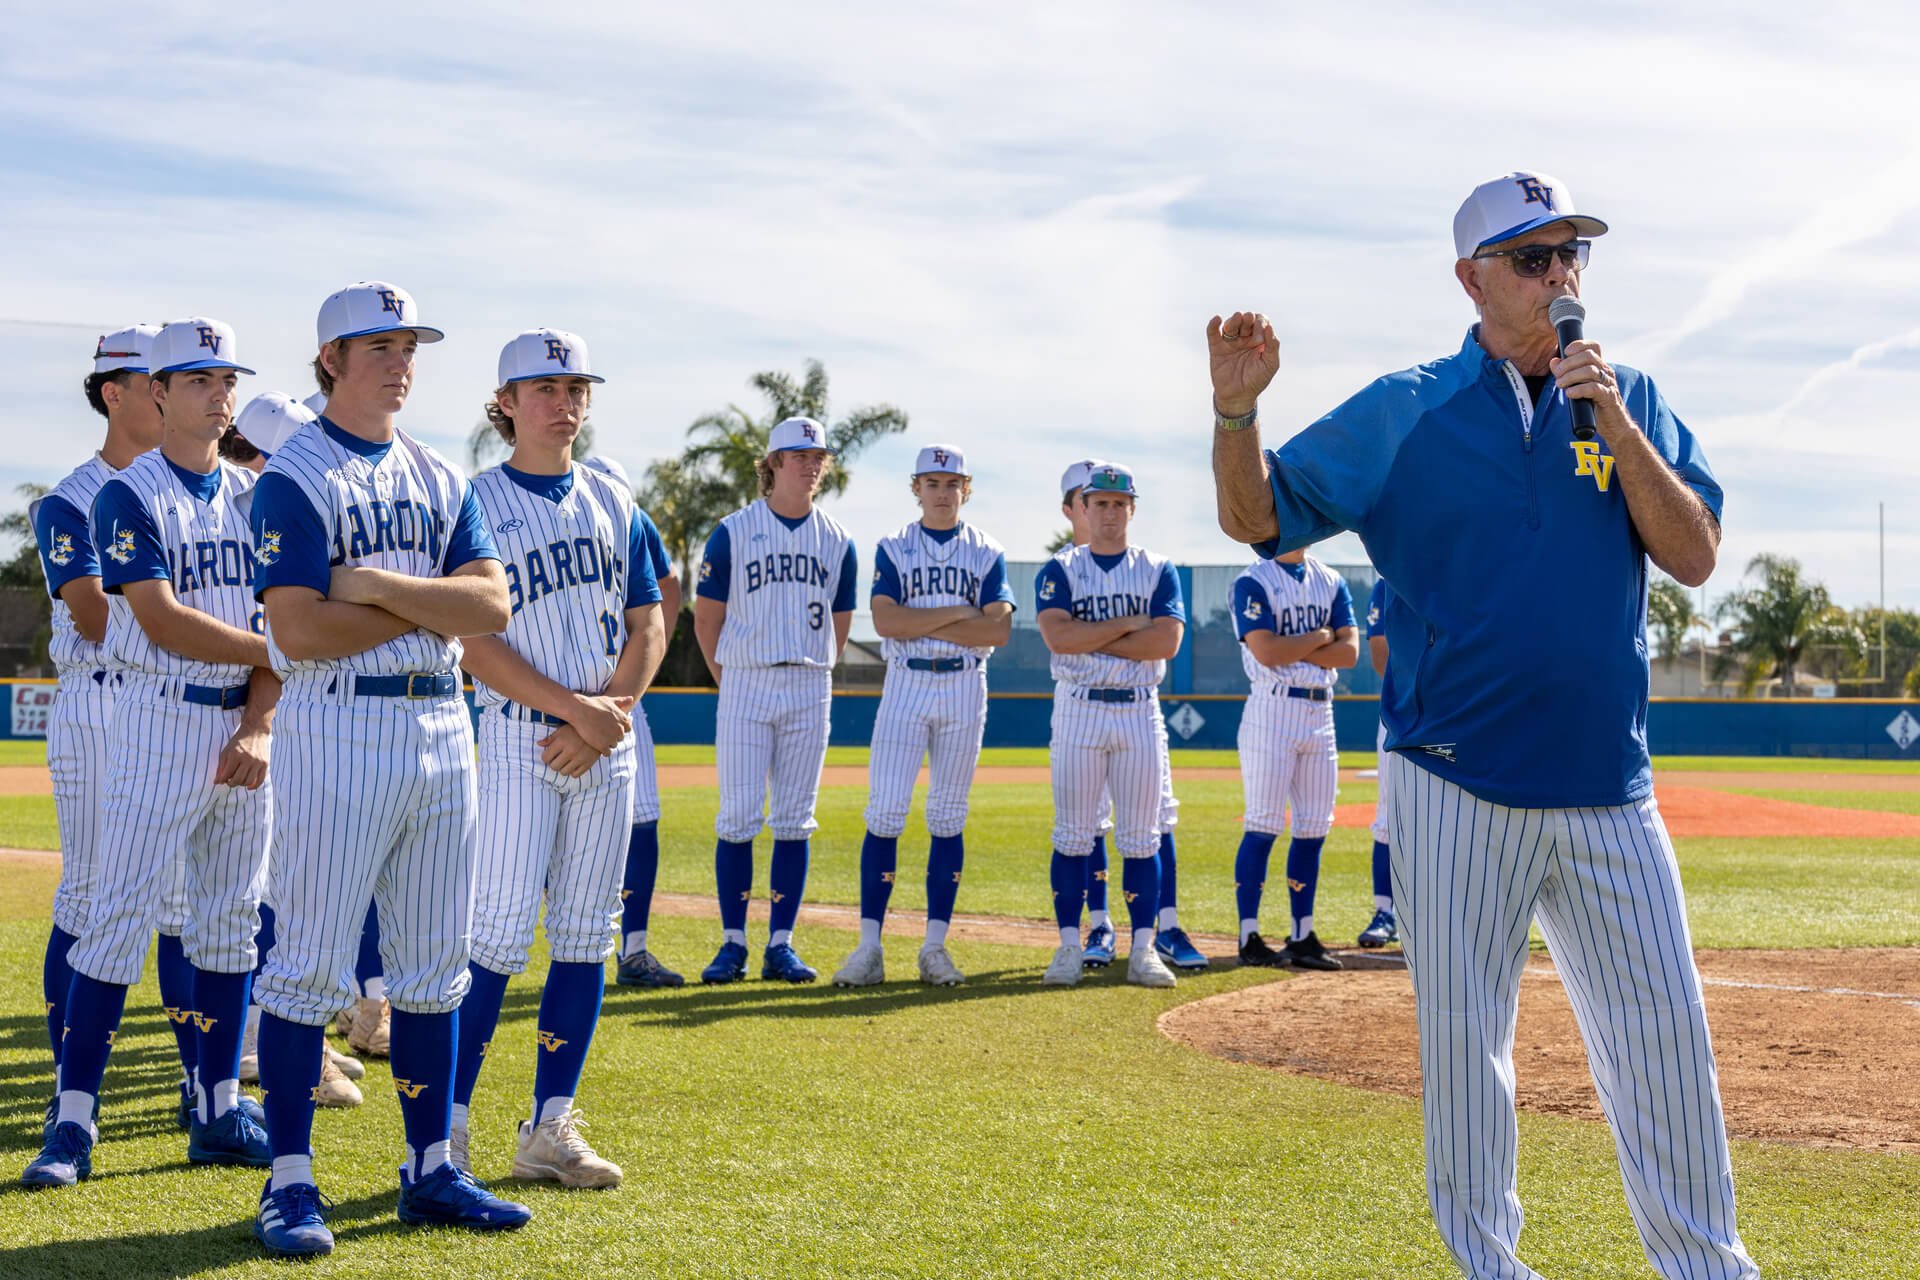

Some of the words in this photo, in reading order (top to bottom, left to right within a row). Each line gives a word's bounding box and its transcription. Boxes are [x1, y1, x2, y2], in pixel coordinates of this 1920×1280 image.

[1516, 177, 1553, 211] FV
[376, 290, 405, 321] FV
[196, 327, 222, 355] FV
[544, 339, 570, 368] FV
[801, 424, 816, 442] FV
[933, 450, 949, 468] FV
[1570, 441, 1614, 493] FV
[168, 540, 255, 594] ARON
[746, 553, 829, 594] BARON
[808, 601, 824, 631] 3
[1072, 593, 1149, 622] BARON
[537, 1030, 568, 1053] FV
